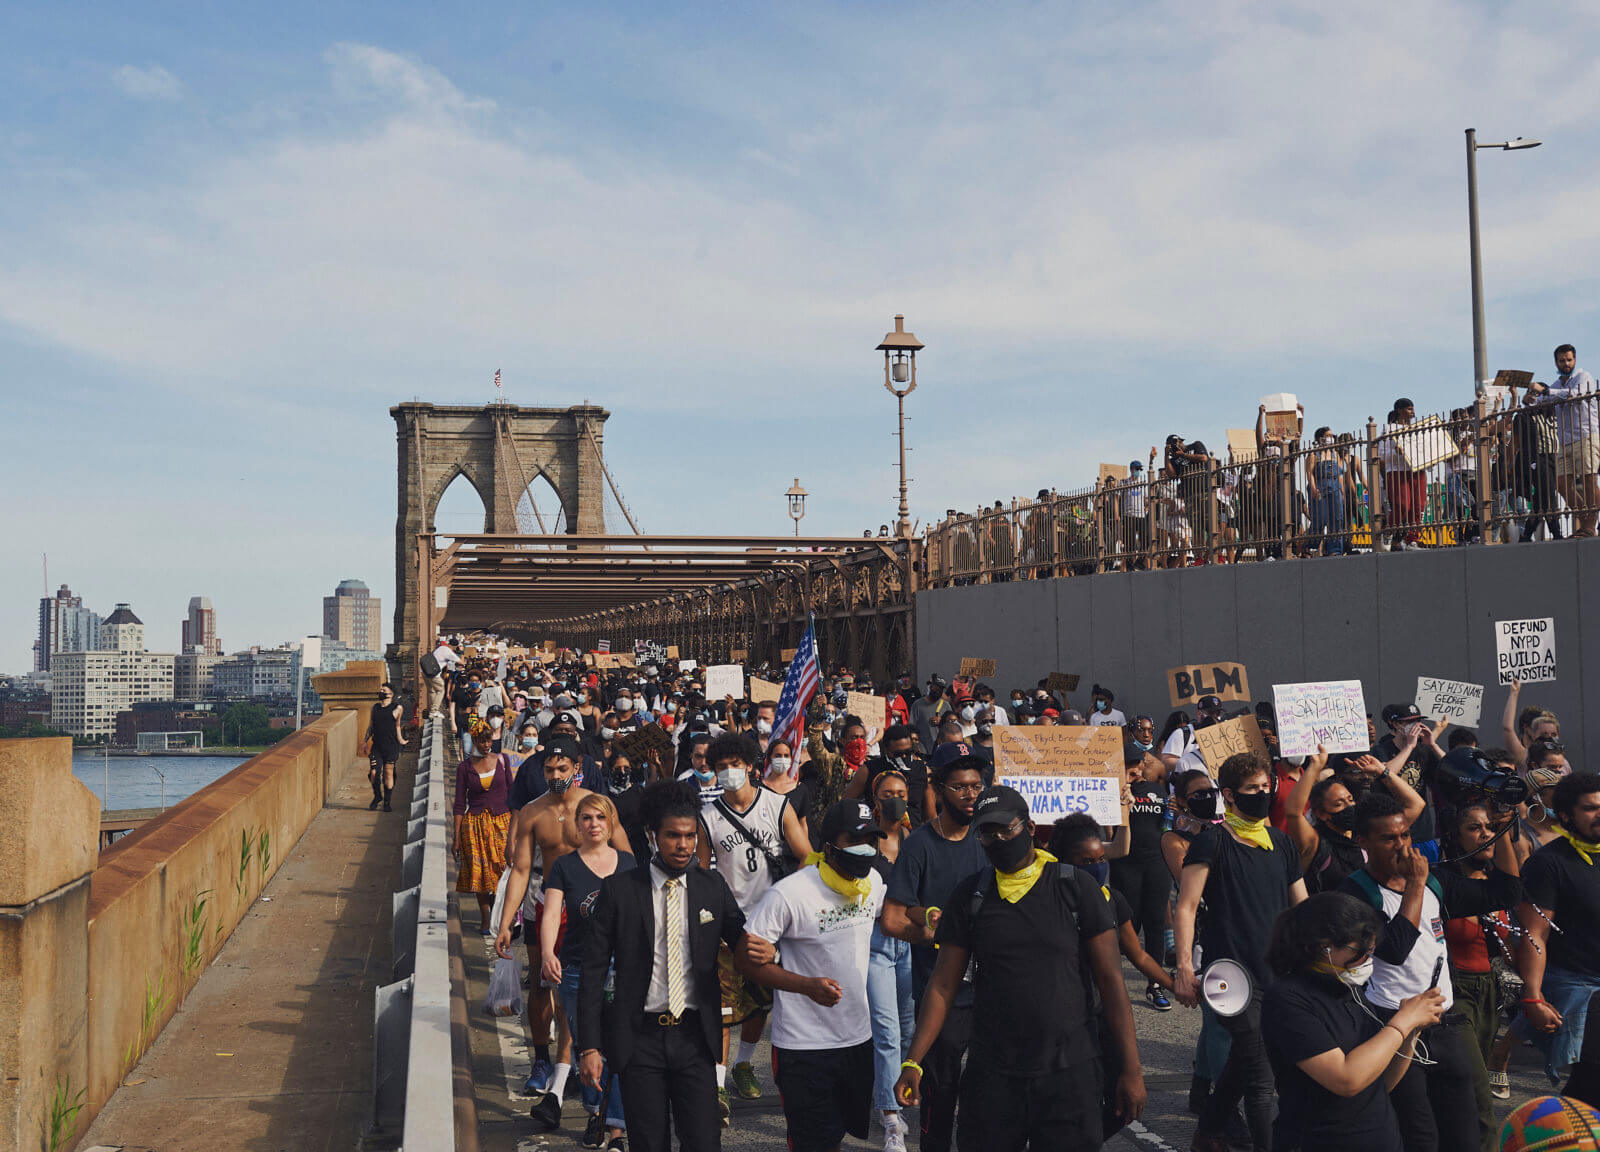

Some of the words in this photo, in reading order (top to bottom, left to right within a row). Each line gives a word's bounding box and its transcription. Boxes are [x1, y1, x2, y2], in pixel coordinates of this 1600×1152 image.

[1503, 620, 1547, 635] DEFUND
[1510, 635, 1541, 650] NYPD
[1499, 651, 1541, 669] BUILD
[1544, 648, 1554, 664] A
[1175, 666, 1243, 699] BLM
[1500, 669, 1521, 684] NEW
[1522, 665, 1556, 680] SYSTEM
[1423, 680, 1447, 692] SAY
[1448, 682, 1463, 694] HIS
[1464, 687, 1483, 698] NAME
[1293, 698, 1320, 719] SAY
[1320, 697, 1363, 720] THEIR
[1431, 703, 1465, 717] FLOYD
[1200, 723, 1248, 749] BLACK
[957, 743, 970, 756] B
[1068, 779, 1108, 792] THEIR
[1031, 795, 1090, 813] NAMES
[746, 847, 758, 873] 8
